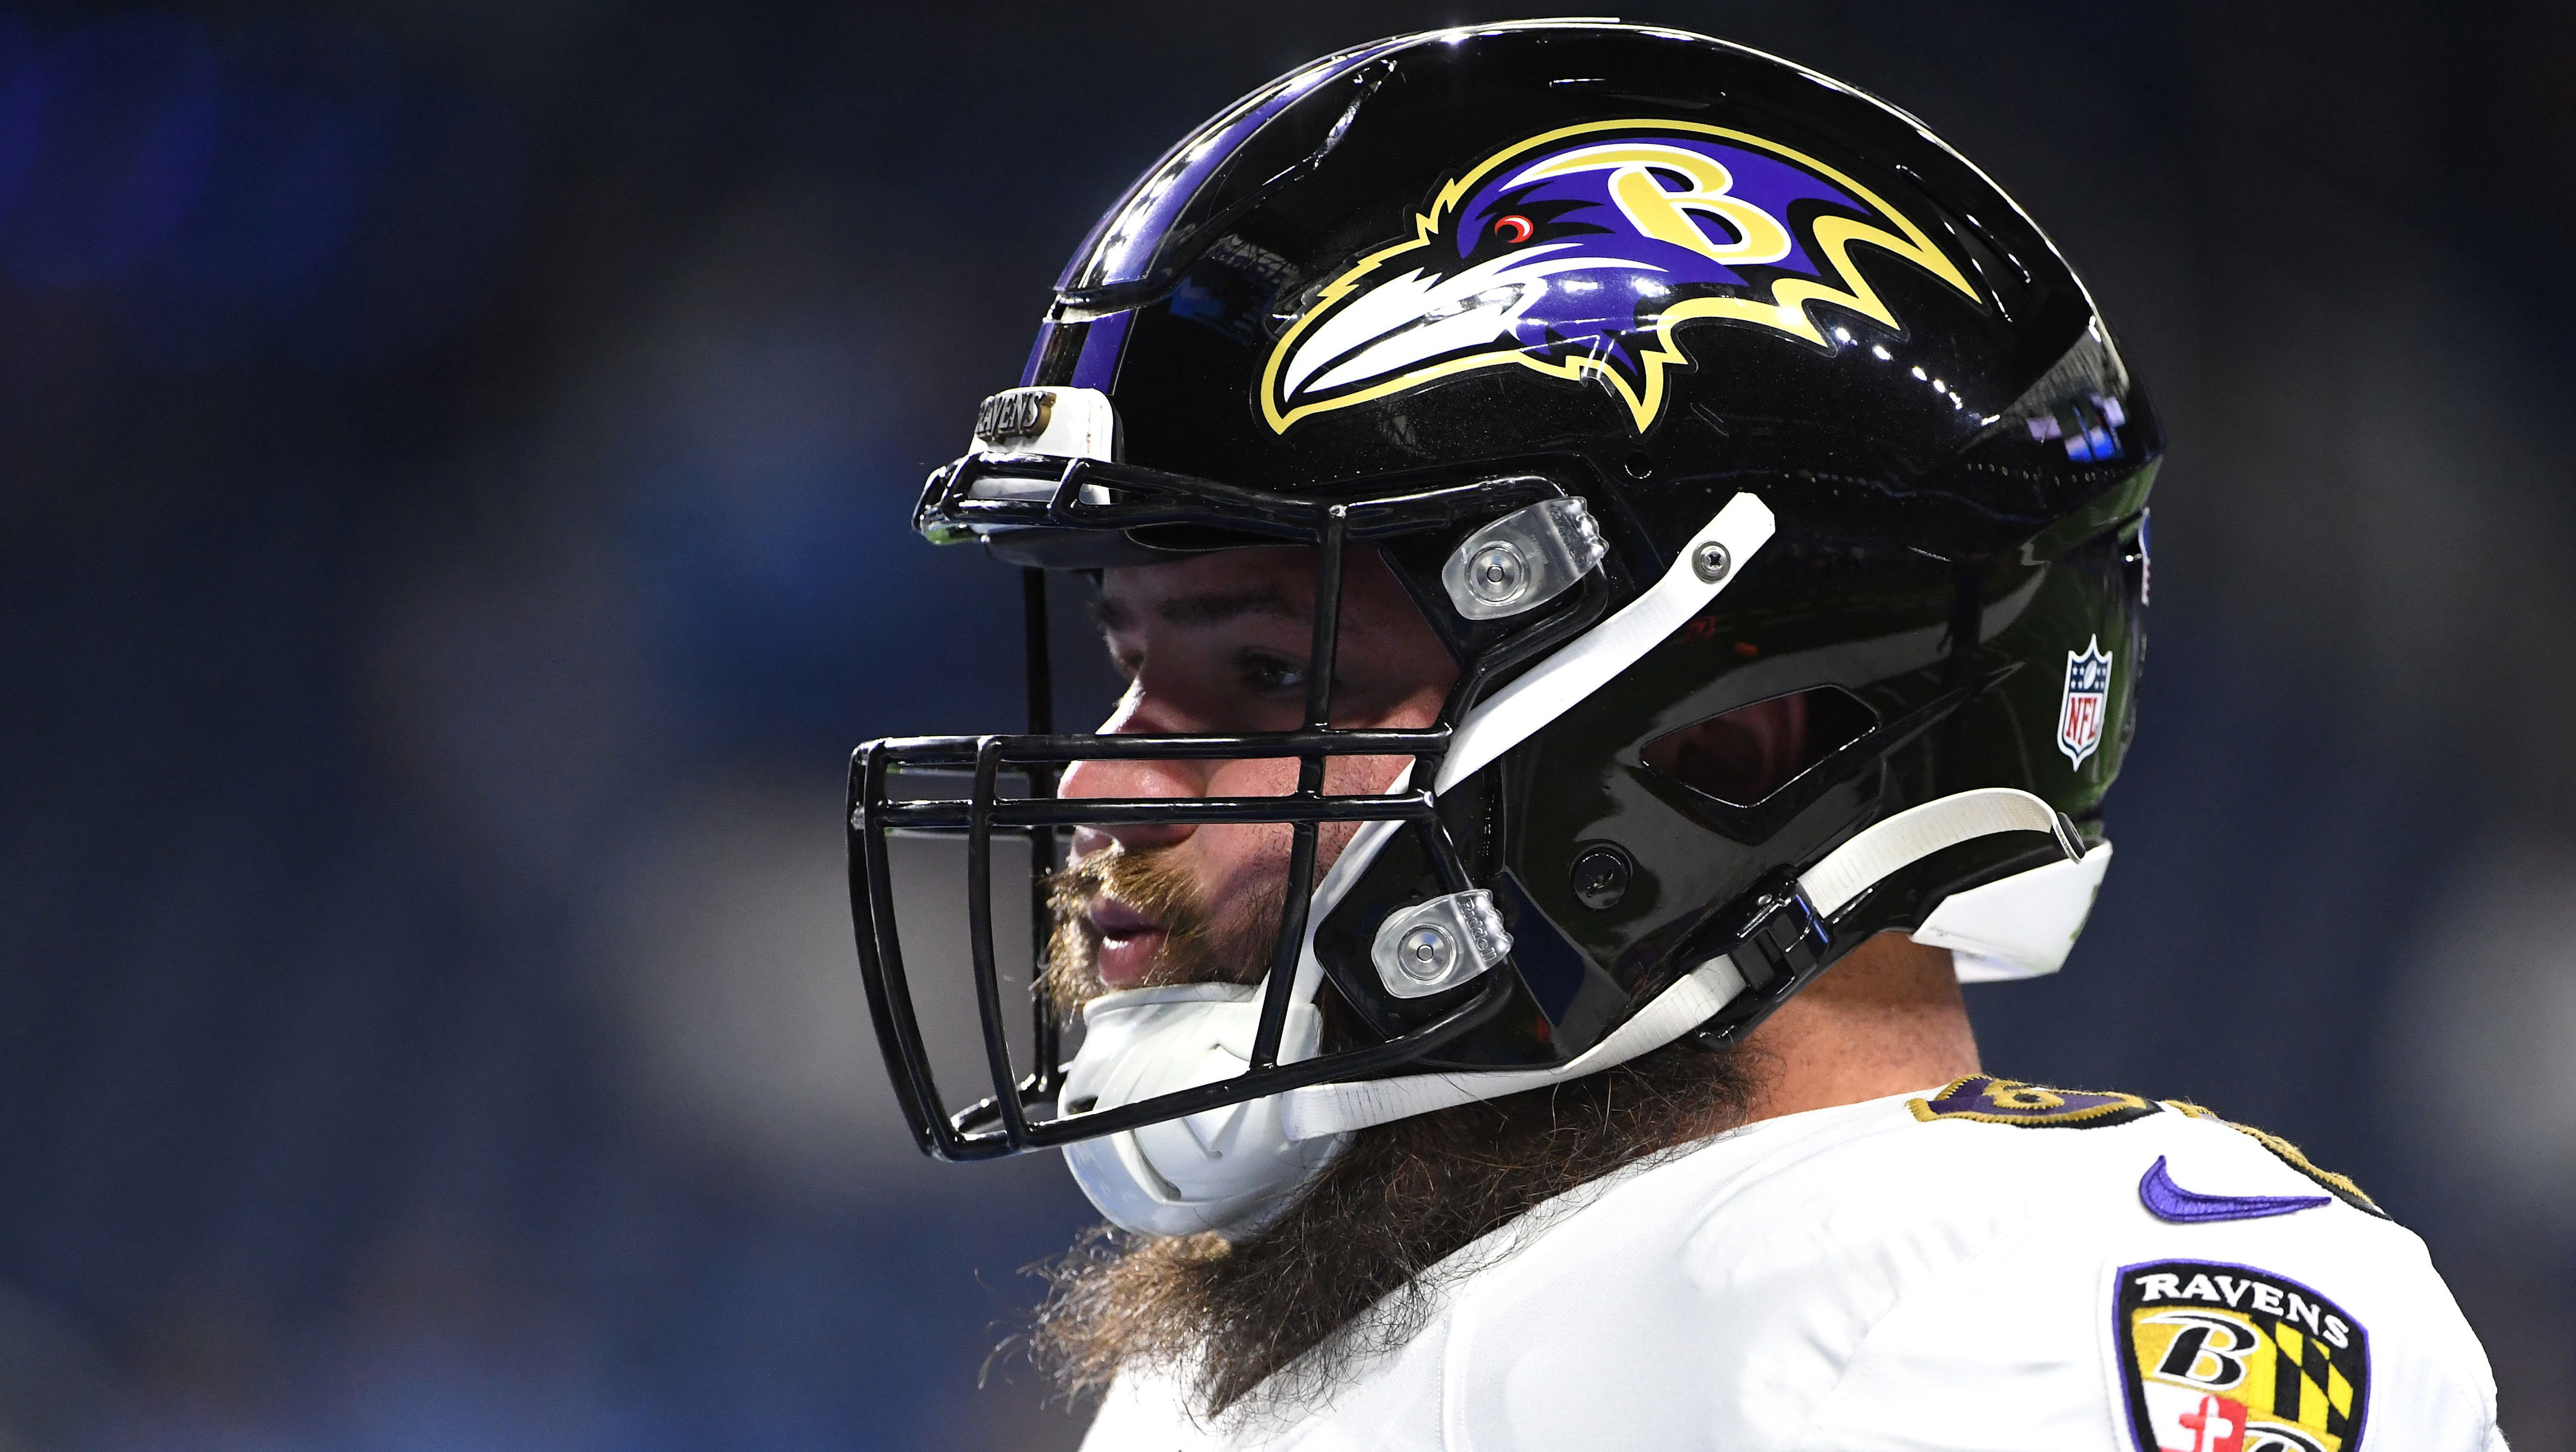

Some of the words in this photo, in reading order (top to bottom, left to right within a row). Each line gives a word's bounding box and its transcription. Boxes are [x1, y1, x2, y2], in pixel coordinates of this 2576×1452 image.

[1499, 143, 1792, 265] B
[2066, 697, 2098, 745] NFL
[1457, 897, 1497, 962] Riddell
[2135, 1273, 2350, 1349] RAVENS
[2139, 1310, 2260, 1391] B
